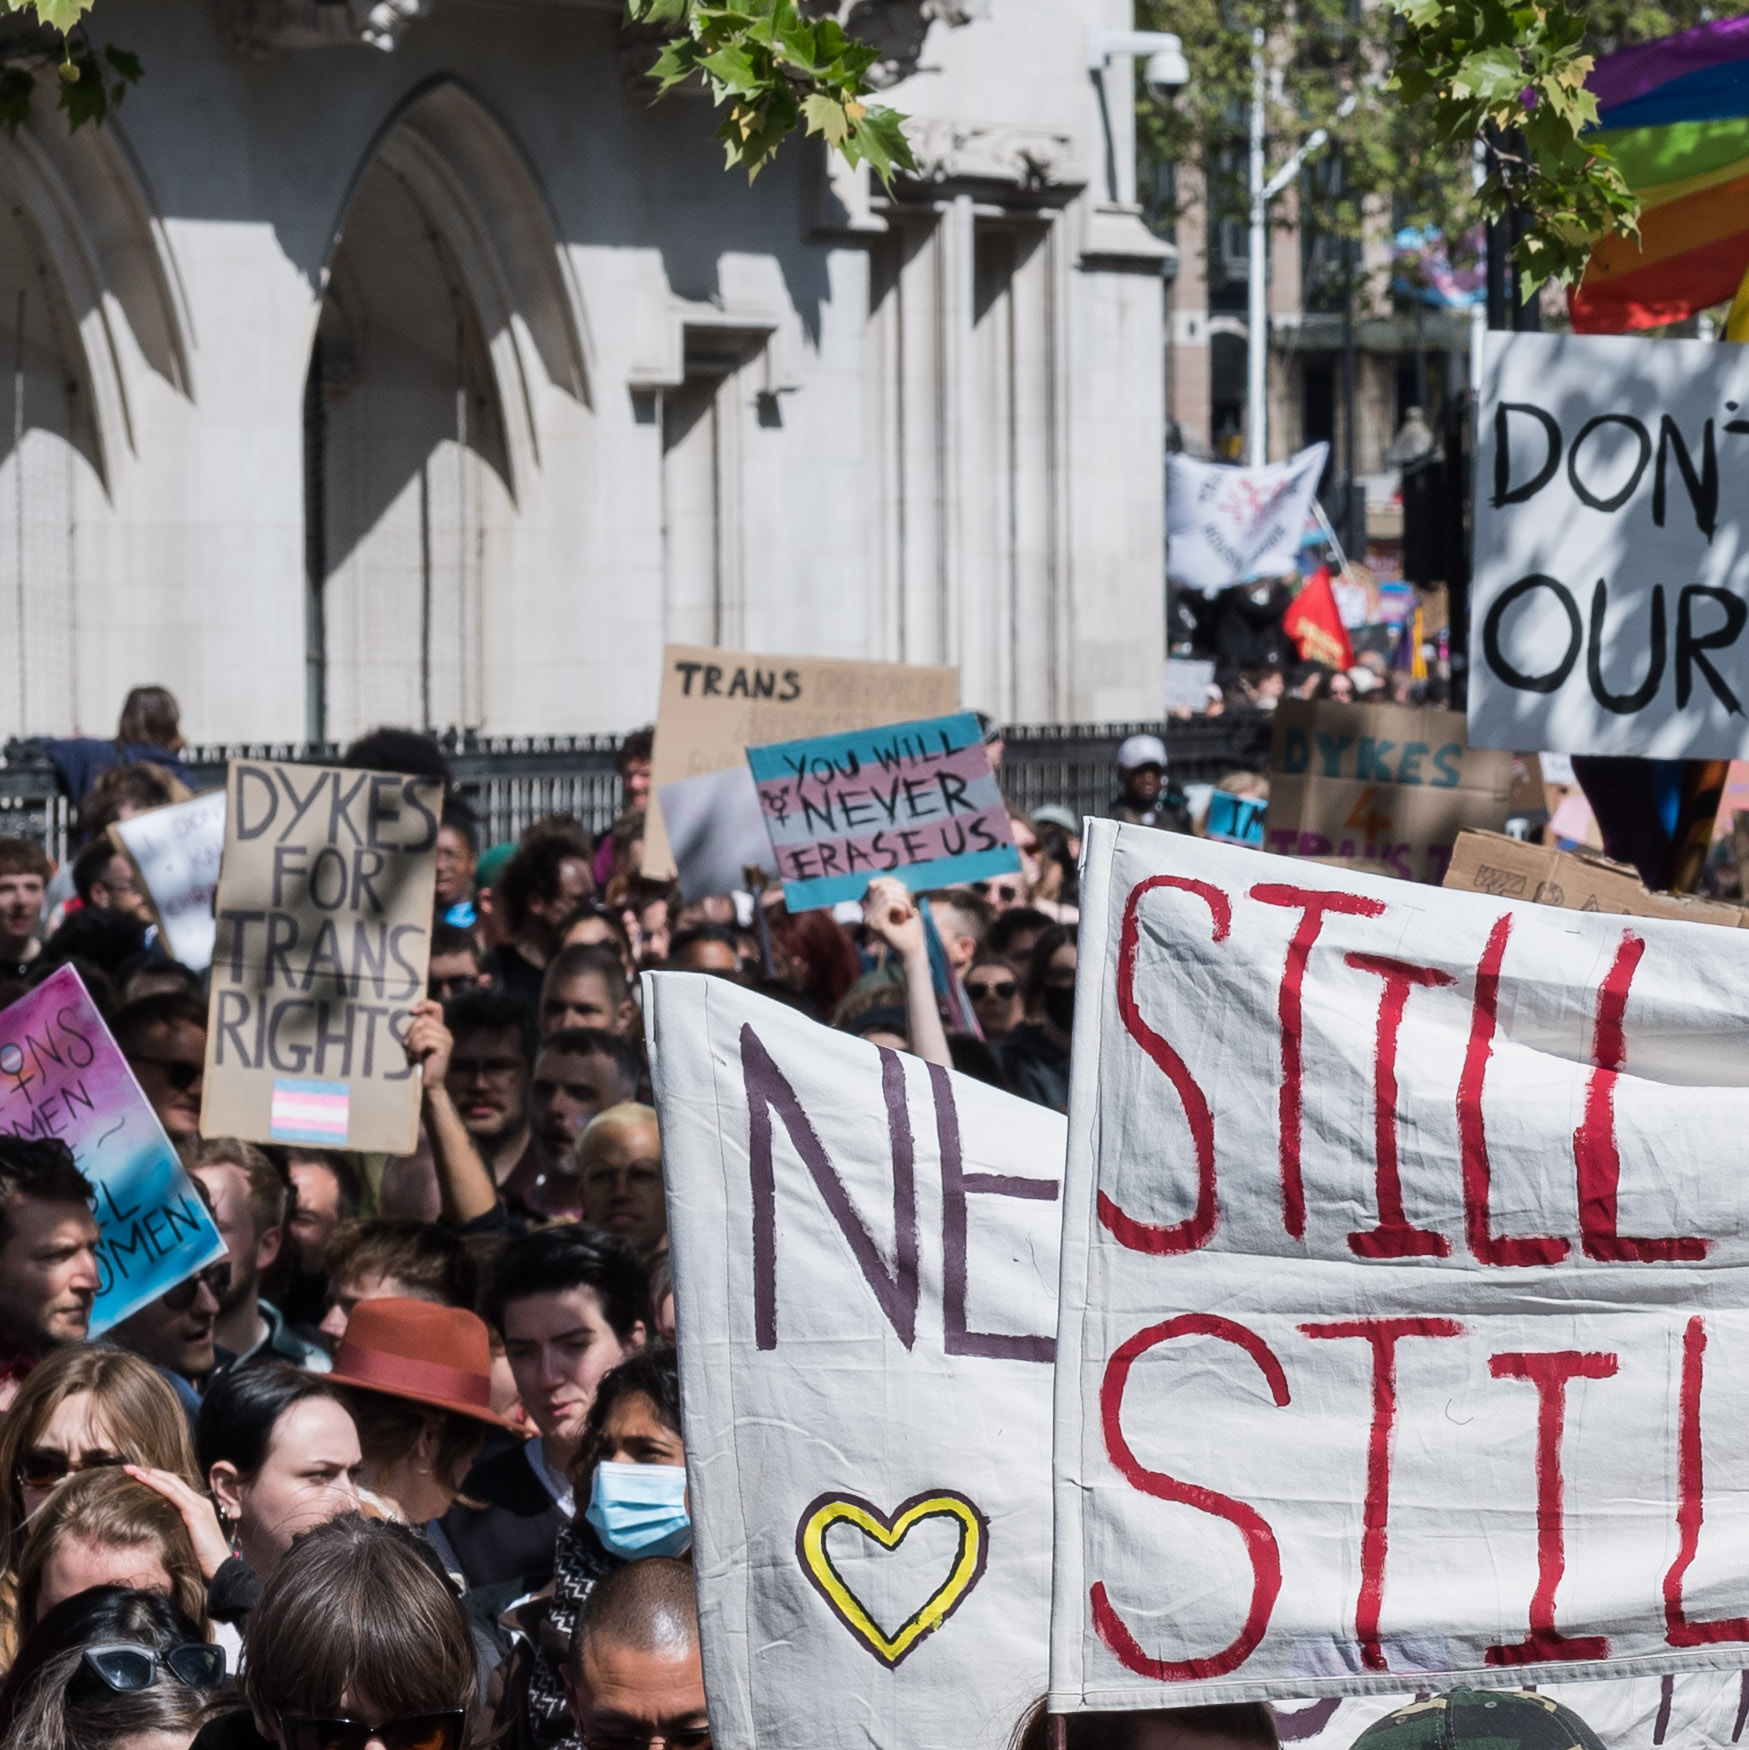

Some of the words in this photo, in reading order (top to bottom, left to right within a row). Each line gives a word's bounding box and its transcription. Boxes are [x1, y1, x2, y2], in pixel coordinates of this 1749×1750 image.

[1482, 572, 1748, 719] OUR
[675, 660, 804, 702] TRANS
[782, 751, 862, 799] YOU
[872, 729, 966, 775] WILL
[1284, 728, 1463, 789] DYKES
[236, 765, 439, 854] DYKES
[799, 770, 980, 836] NEVER
[1344, 785, 1394, 843] 4
[272, 845, 384, 914] FOR
[786, 830, 934, 882] ERASE
[219, 909, 427, 1001] TRANS
[214, 989, 416, 1082] RIGHTS
[1096, 873, 1716, 1268] STILL
